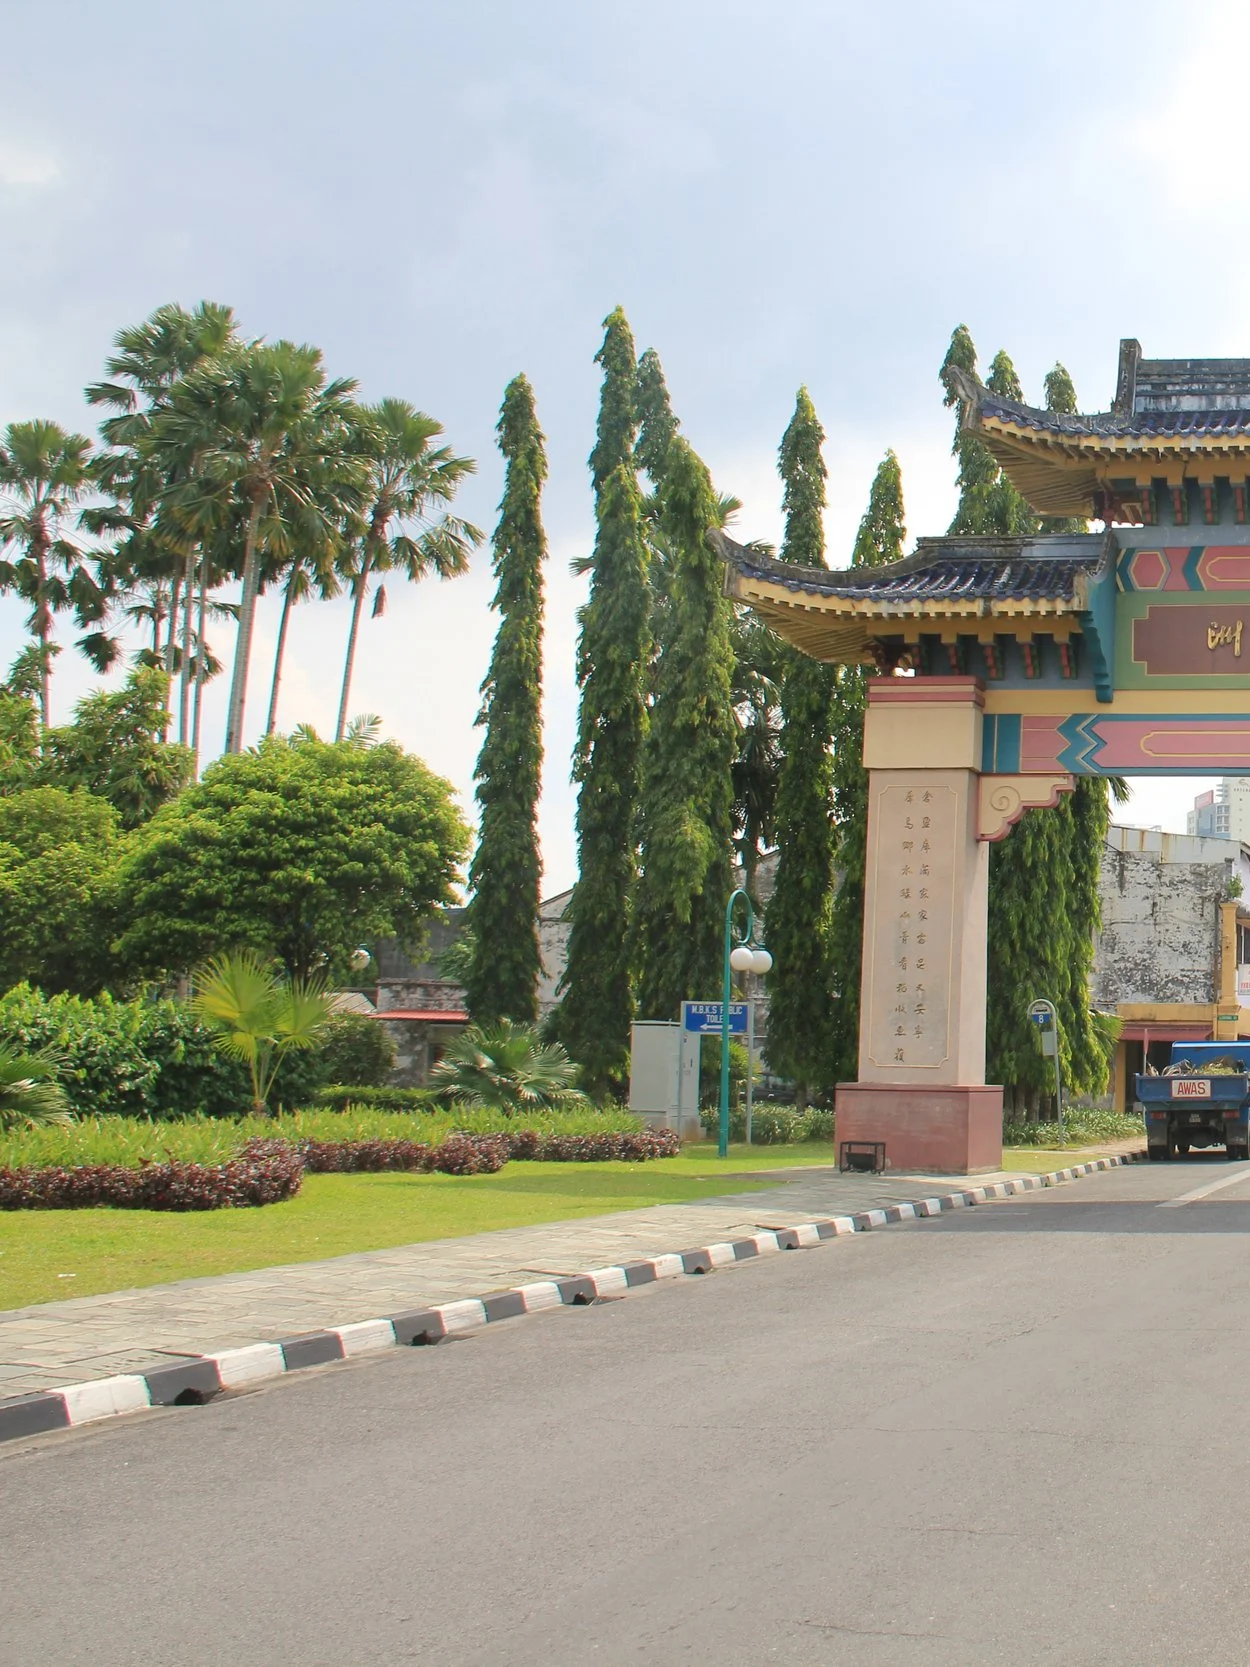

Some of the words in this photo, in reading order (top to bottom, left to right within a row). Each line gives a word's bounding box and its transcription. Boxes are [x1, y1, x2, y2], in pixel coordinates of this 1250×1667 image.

[720, 1005, 743, 1015] PBLIC
[706, 1014, 726, 1023] TOILE
[1177, 1081, 1206, 1096] AWAS
